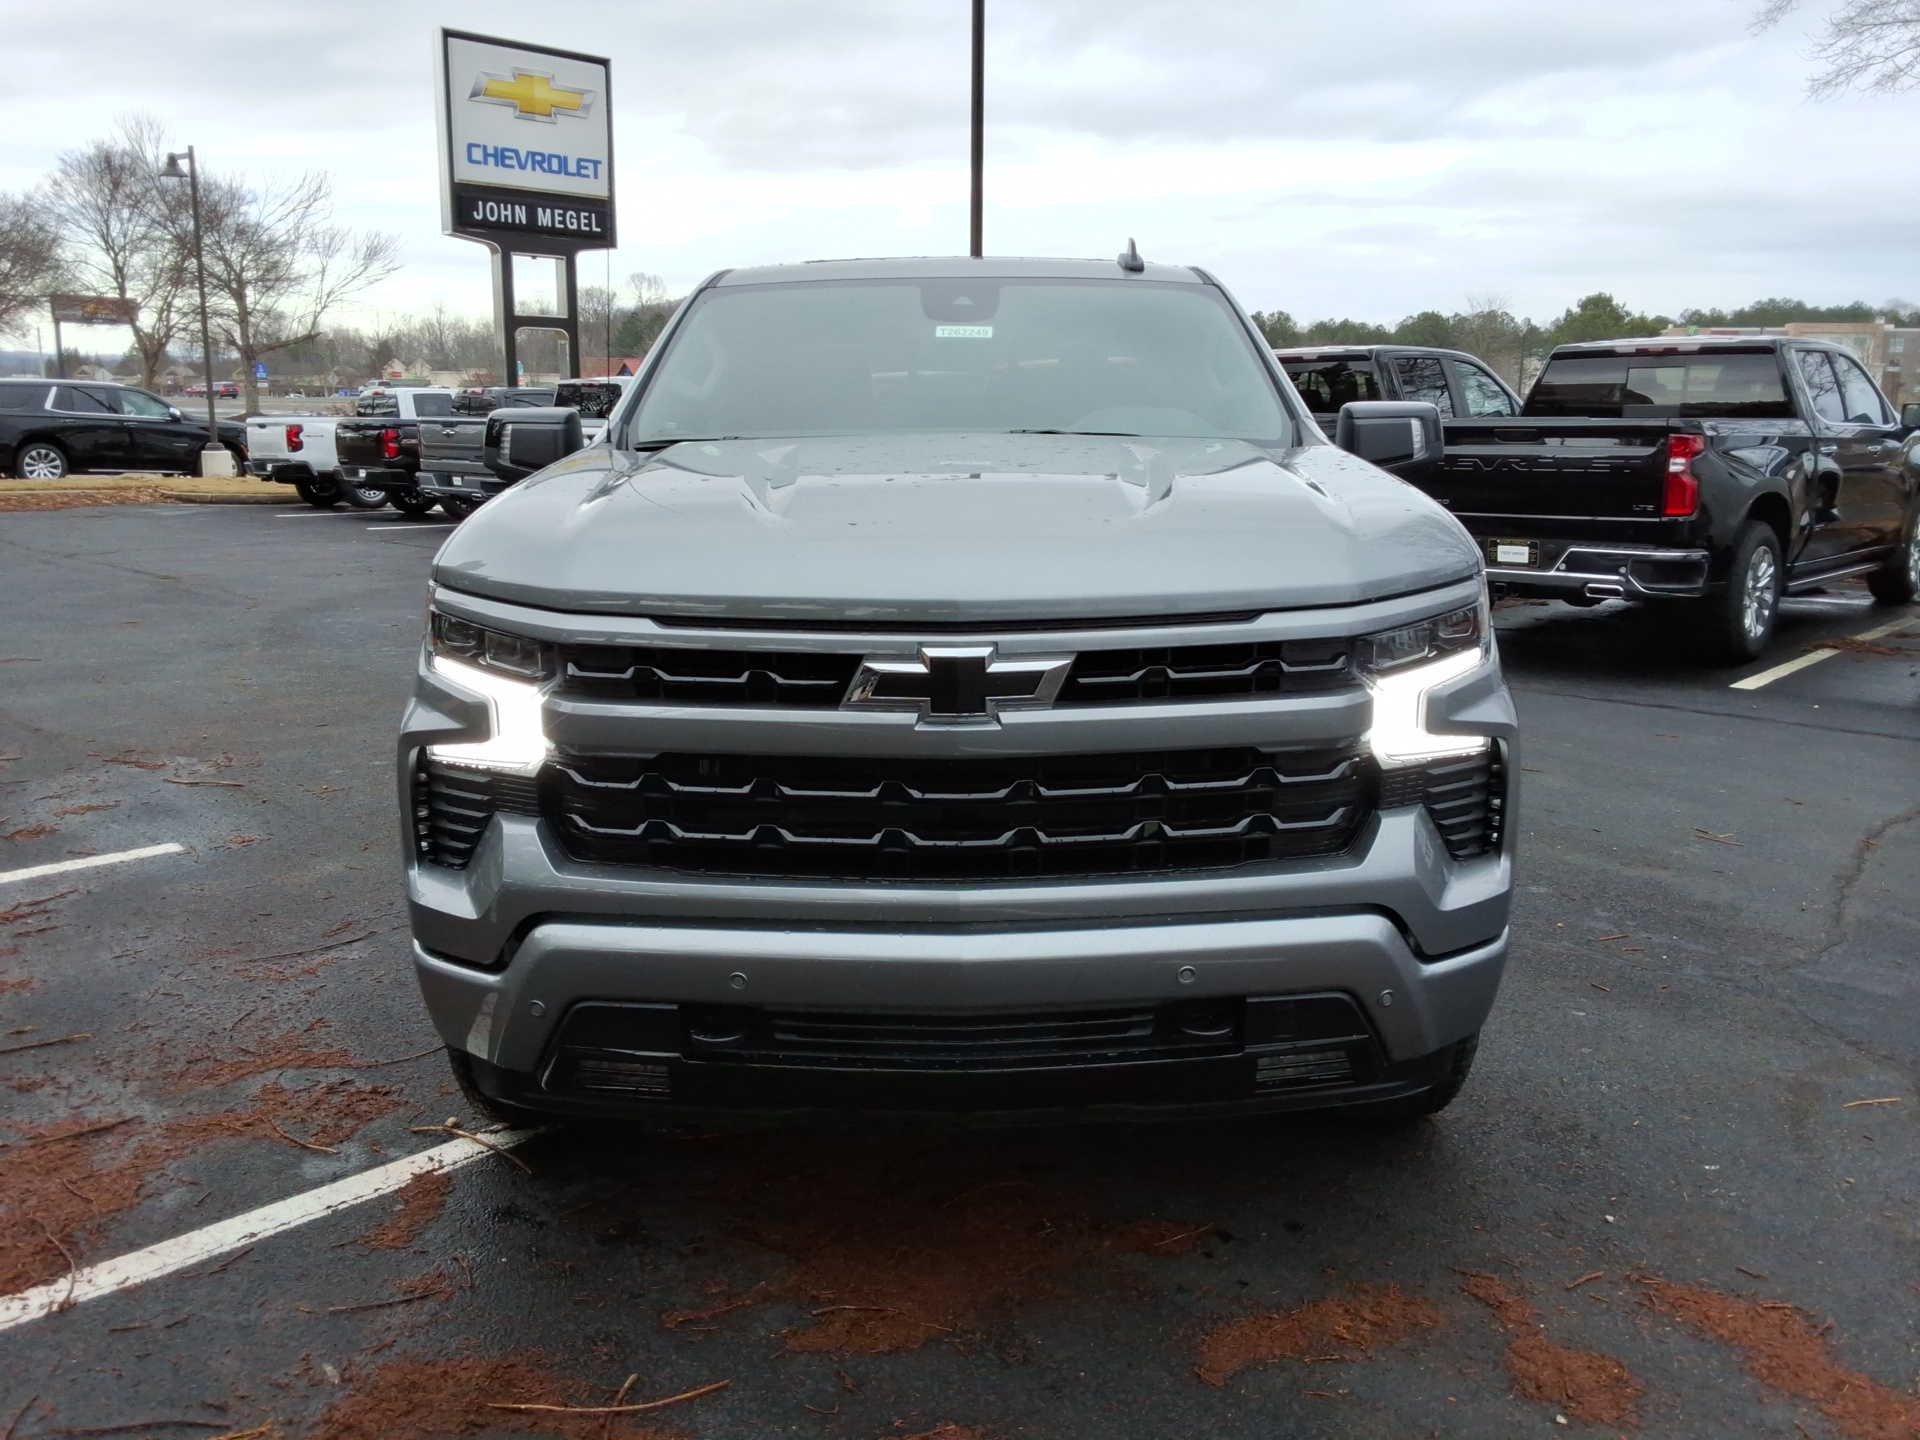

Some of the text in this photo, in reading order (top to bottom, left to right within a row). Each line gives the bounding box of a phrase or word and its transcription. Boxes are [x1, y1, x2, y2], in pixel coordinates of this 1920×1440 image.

[466, 142, 602, 180] CHEVROLET
[473, 200, 602, 232] JOHN MEGEL
[940, 327, 989, 337] T262249
